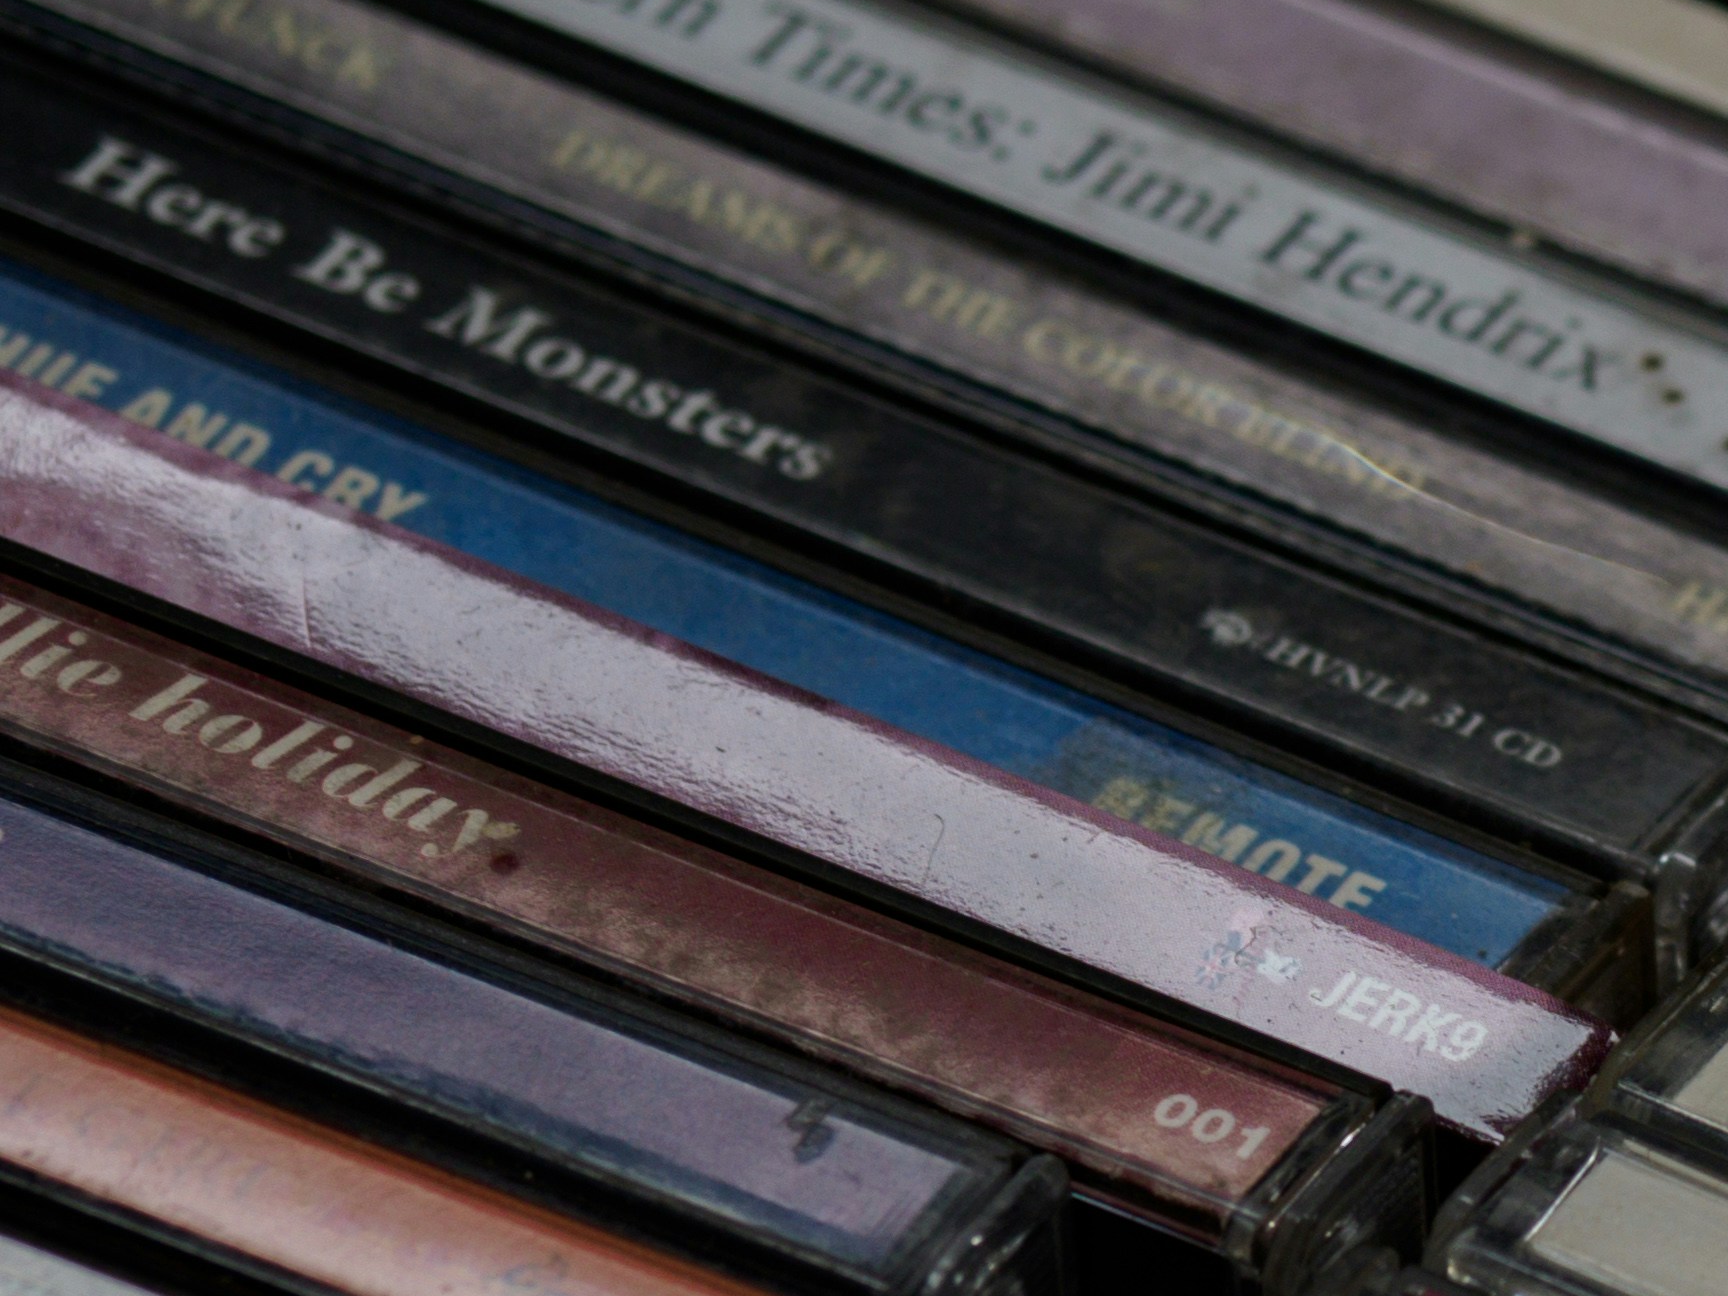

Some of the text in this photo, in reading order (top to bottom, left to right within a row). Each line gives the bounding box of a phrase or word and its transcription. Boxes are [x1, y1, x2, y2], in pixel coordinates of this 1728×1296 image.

[547, 133, 811, 258] DREAMS
[1039, 125, 1252, 241] Jimi
[1259, 206, 1625, 395] Hendrix
[59, 133, 1565, 773] Here Be Monsters HVNLP 31 CD
[115, 387, 275, 471] AND
[275, 446, 432, 522] CRY
[1089, 775, 1389, 916] REMOTE
[129, 672, 522, 857] holiday
[1153, 1093, 1272, 1162] 001
[1310, 970, 1490, 1063] JERK9
